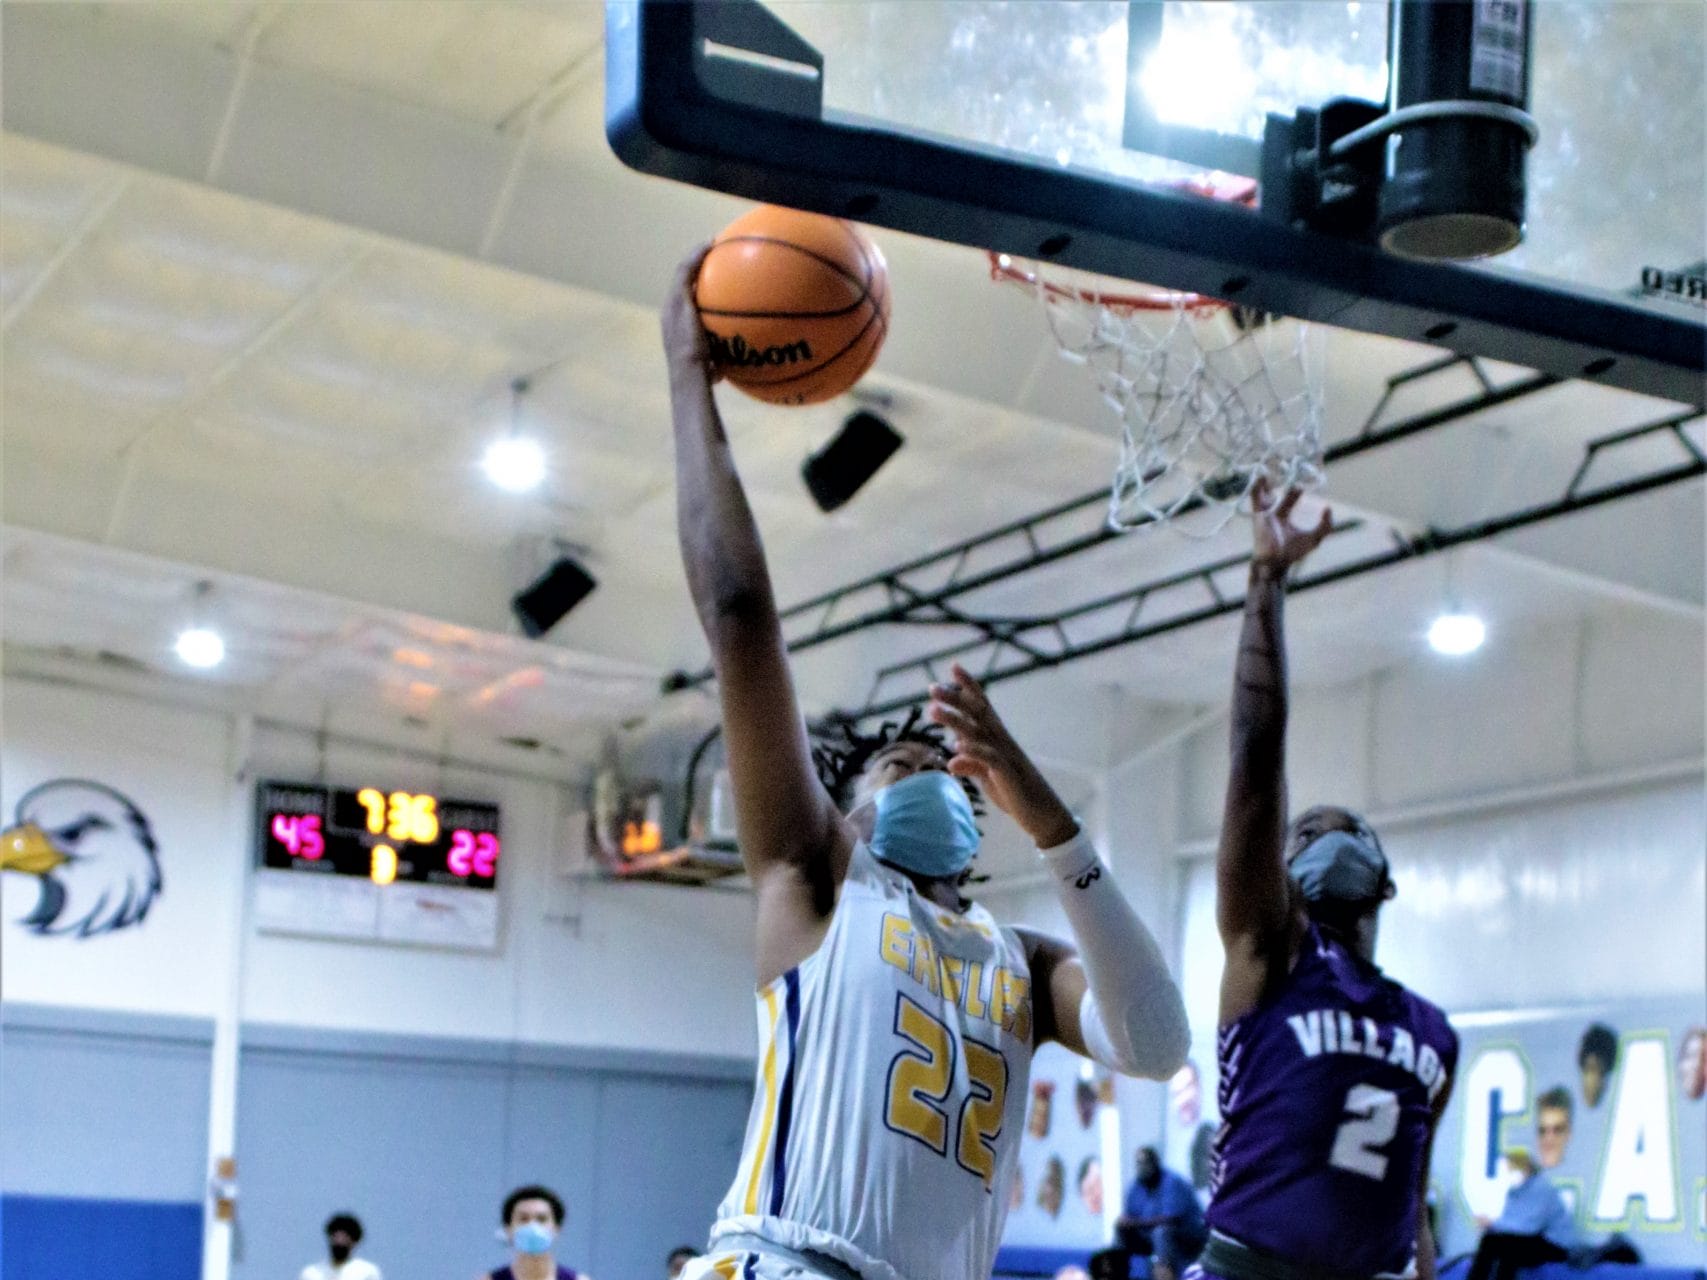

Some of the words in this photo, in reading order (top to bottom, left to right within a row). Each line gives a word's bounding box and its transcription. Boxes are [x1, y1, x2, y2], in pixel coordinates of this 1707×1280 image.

[272, 814, 325, 860] 45
[448, 829, 500, 877] 22
[883, 990, 1009, 1192] 22
[1329, 1082, 1401, 1182] 2
